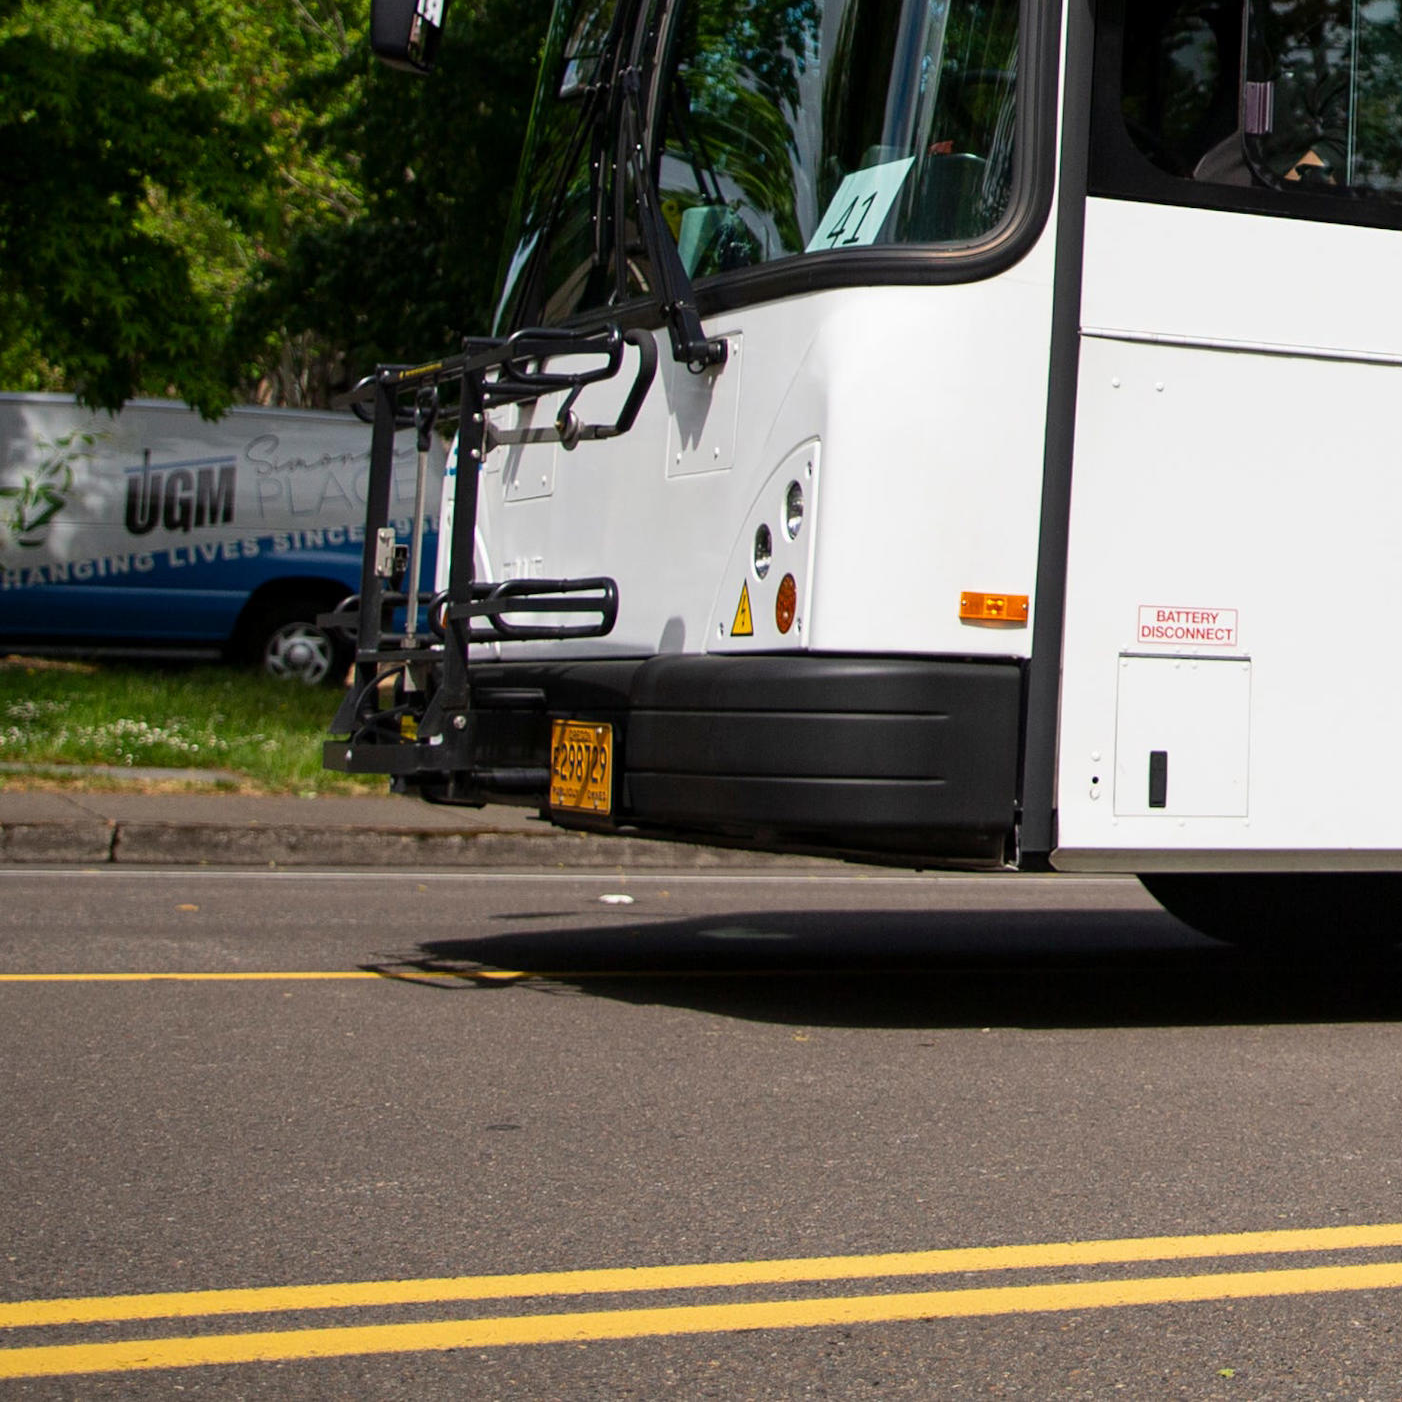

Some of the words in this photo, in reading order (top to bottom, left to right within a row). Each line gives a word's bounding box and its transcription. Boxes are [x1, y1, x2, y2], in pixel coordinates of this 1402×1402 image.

[827, 191, 878, 249] 41
[125, 449, 237, 535] UGM
[169, 536, 260, 569] LIVES
[273, 523, 366, 554] SINCE
[1141, 626, 1232, 640] DISCONNECT
[1156, 610, 1218, 624] BATTERY
